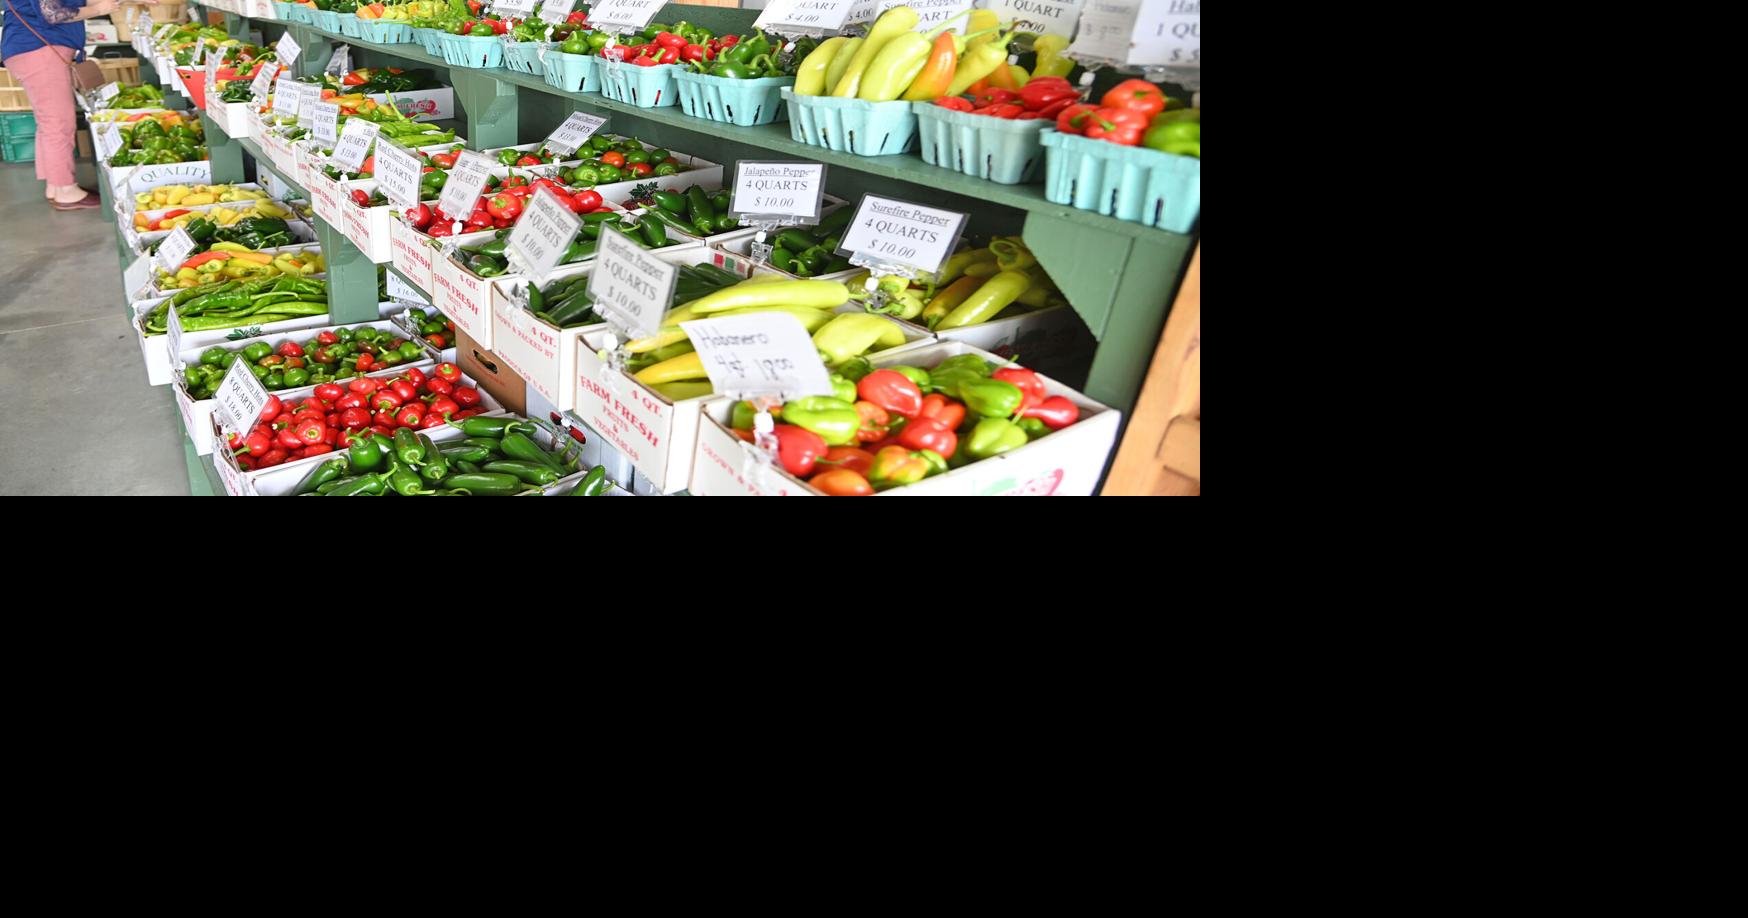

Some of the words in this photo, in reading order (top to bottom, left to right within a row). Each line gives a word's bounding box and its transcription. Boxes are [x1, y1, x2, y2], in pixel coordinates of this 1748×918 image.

[1013, 0, 1066, 19] QUART
[140, 166, 208, 183] QUALITY
[383, 160, 414, 185] QUARTS
[743, 166, 781, 177] Jalapeño
[745, 179, 753, 190] 4
[755, 179, 809, 192] QUARTS
[764, 196, 795, 208] 10.00
[871, 200, 911, 217] Surefire
[912, 208, 952, 227] Pepper
[533, 213, 563, 249] QUARTS
[865, 218, 874, 229] 4
[875, 219, 940, 244] QUARTS
[407, 246, 433, 271] FRESH
[879, 241, 917, 260] 10.00
[466, 279, 480, 292] QT.
[611, 262, 658, 301] QUARTS
[451, 283, 480, 316] FRESH
[539, 331, 557, 348] QT.
[232, 381, 256, 415] QUARTS
[642, 397, 663, 418] QT.
[580, 375, 612, 404] FARM
[613, 399, 660, 448] FRESH
